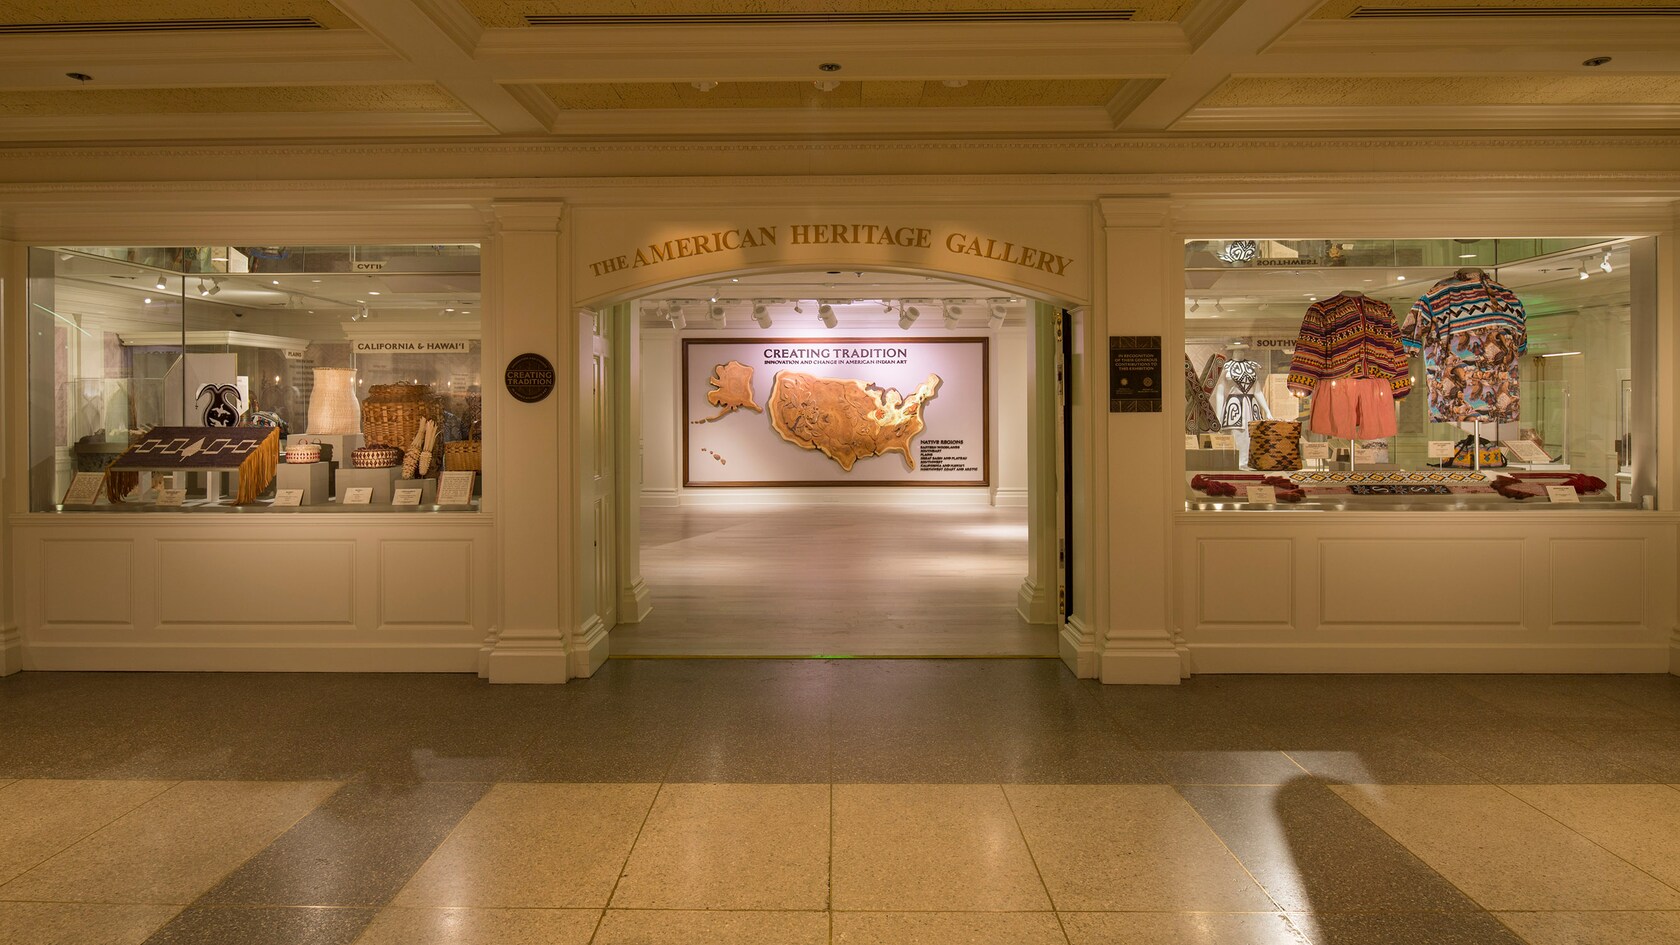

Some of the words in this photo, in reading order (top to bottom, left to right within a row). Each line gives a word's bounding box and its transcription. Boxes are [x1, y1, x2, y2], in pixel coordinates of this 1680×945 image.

[589, 255, 630, 278] THE
[631, 226, 777, 269] AMERICAN
[790, 223, 932, 249] HERITAGE
[945, 232, 1074, 277] GALLERY
[763, 348, 830, 359] CREATING
[833, 348, 907, 358] TRADITION
[507, 371, 552, 379] CREATING
